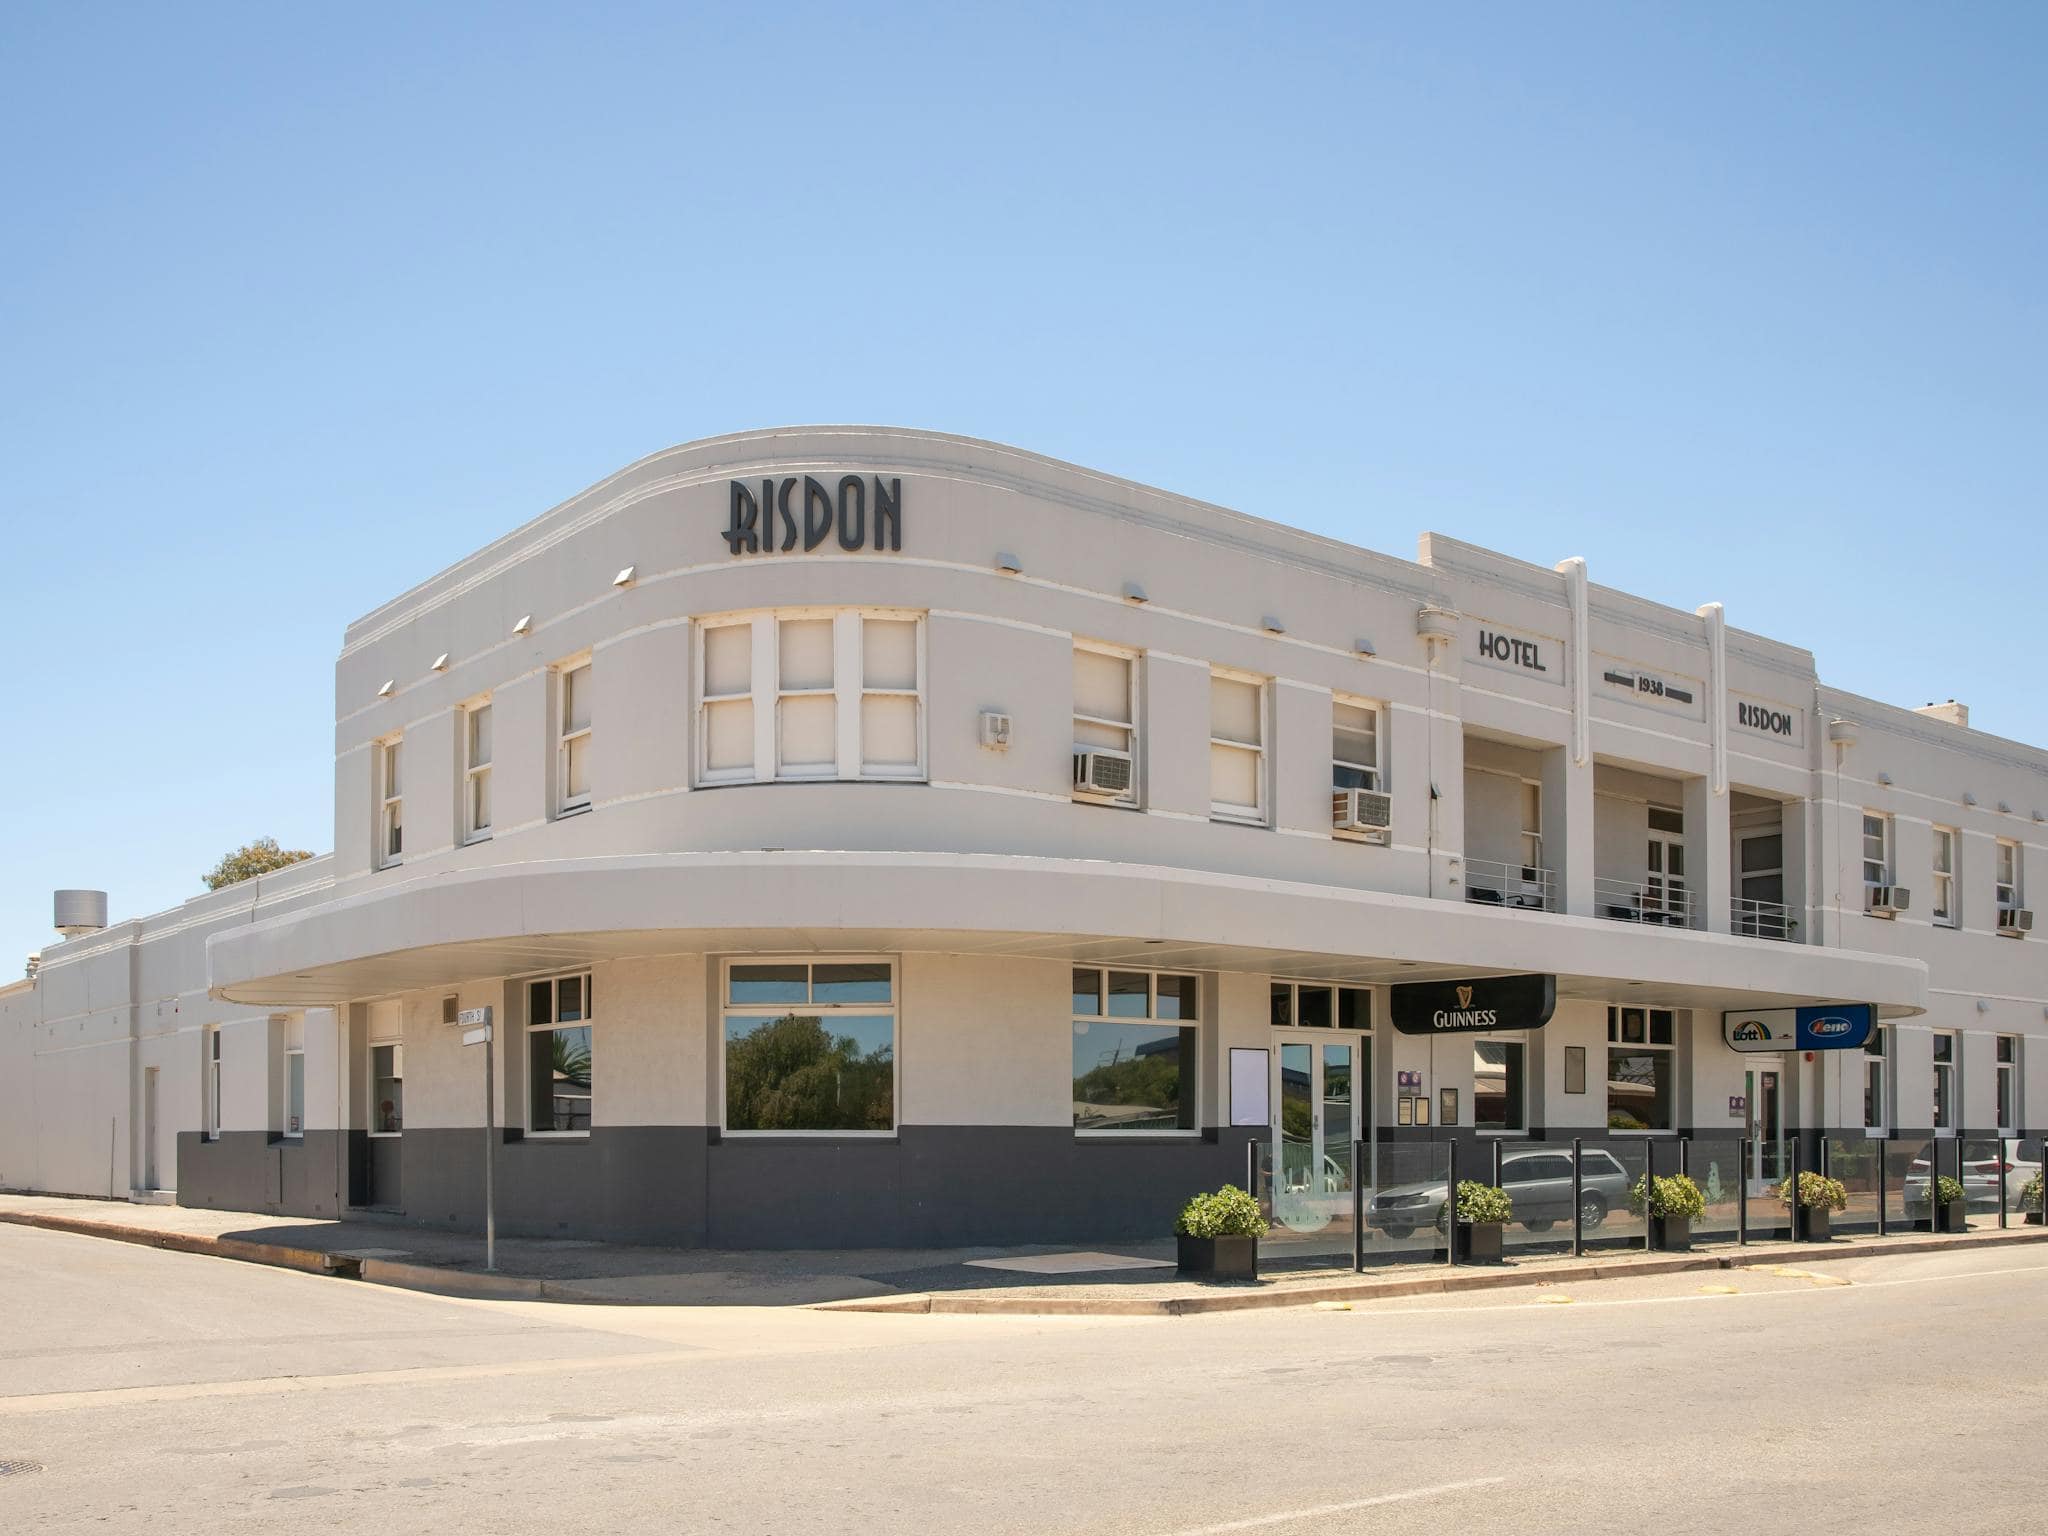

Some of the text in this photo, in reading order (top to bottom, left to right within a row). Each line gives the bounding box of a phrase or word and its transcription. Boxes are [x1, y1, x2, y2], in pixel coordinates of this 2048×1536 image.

[721, 474, 901, 555] RISDON
[1479, 630, 1546, 671] HOTEL
[1638, 676, 1664, 697] 1938
[1738, 702, 1792, 736] RISDON
[1433, 1009, 1497, 1028] GUINNESS
